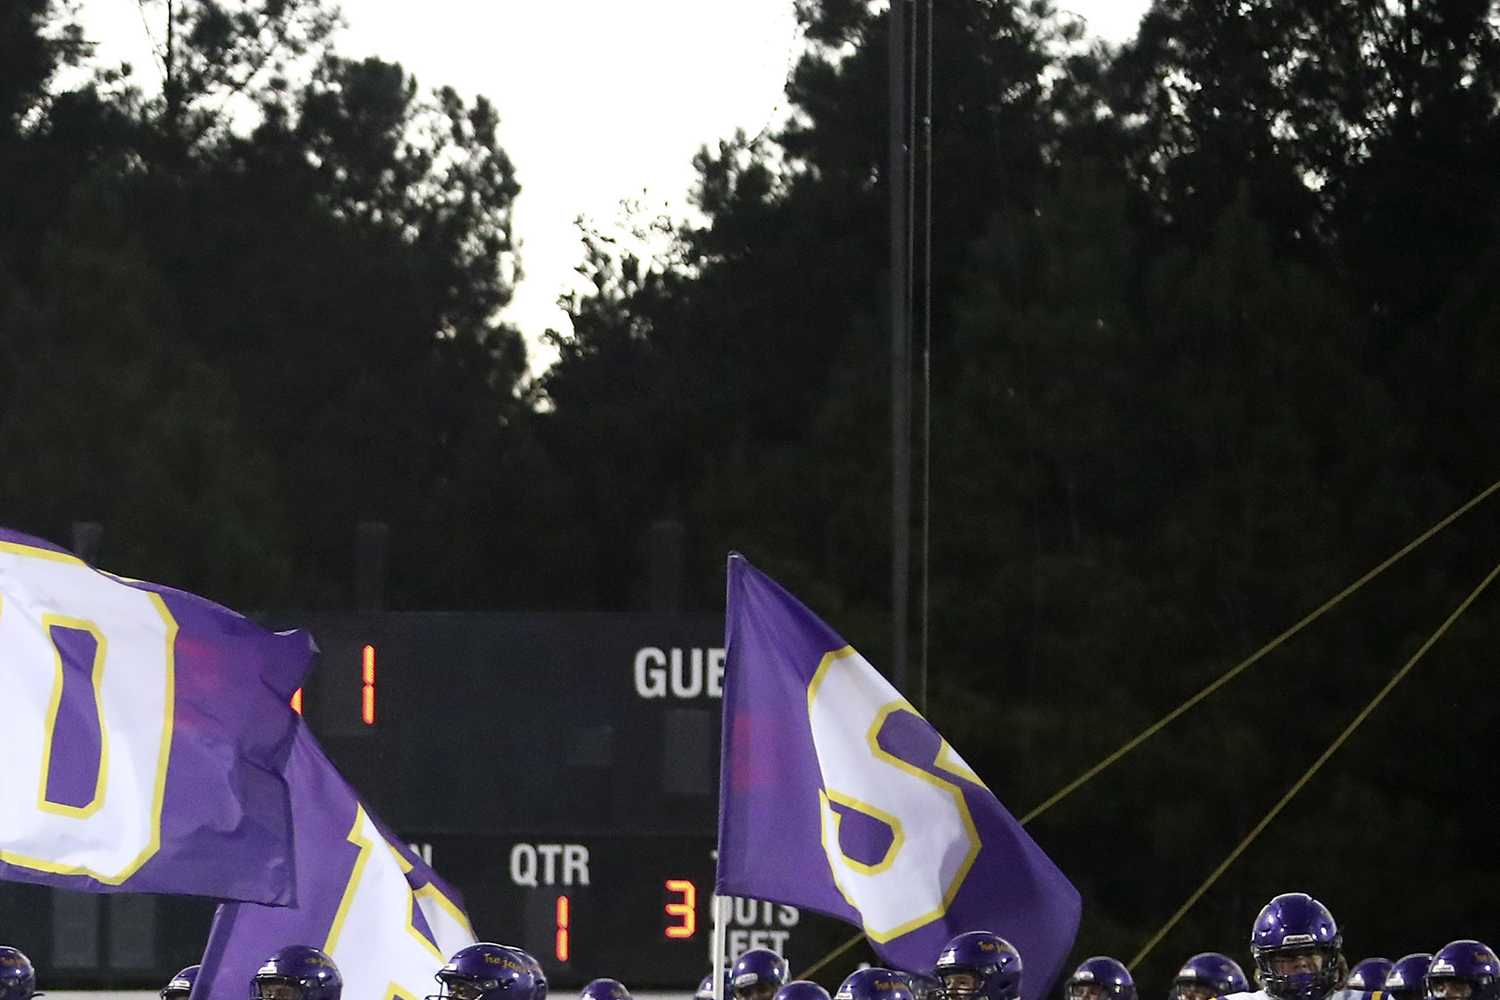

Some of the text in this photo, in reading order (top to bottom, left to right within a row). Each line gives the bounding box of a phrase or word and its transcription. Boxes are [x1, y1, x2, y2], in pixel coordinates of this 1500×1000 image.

[634, 646, 726, 699] GUE
[807, 644, 990, 944] S
[510, 843, 590, 888] QTR
[556, 895, 569, 962] 1
[664, 879, 696, 938] 3
